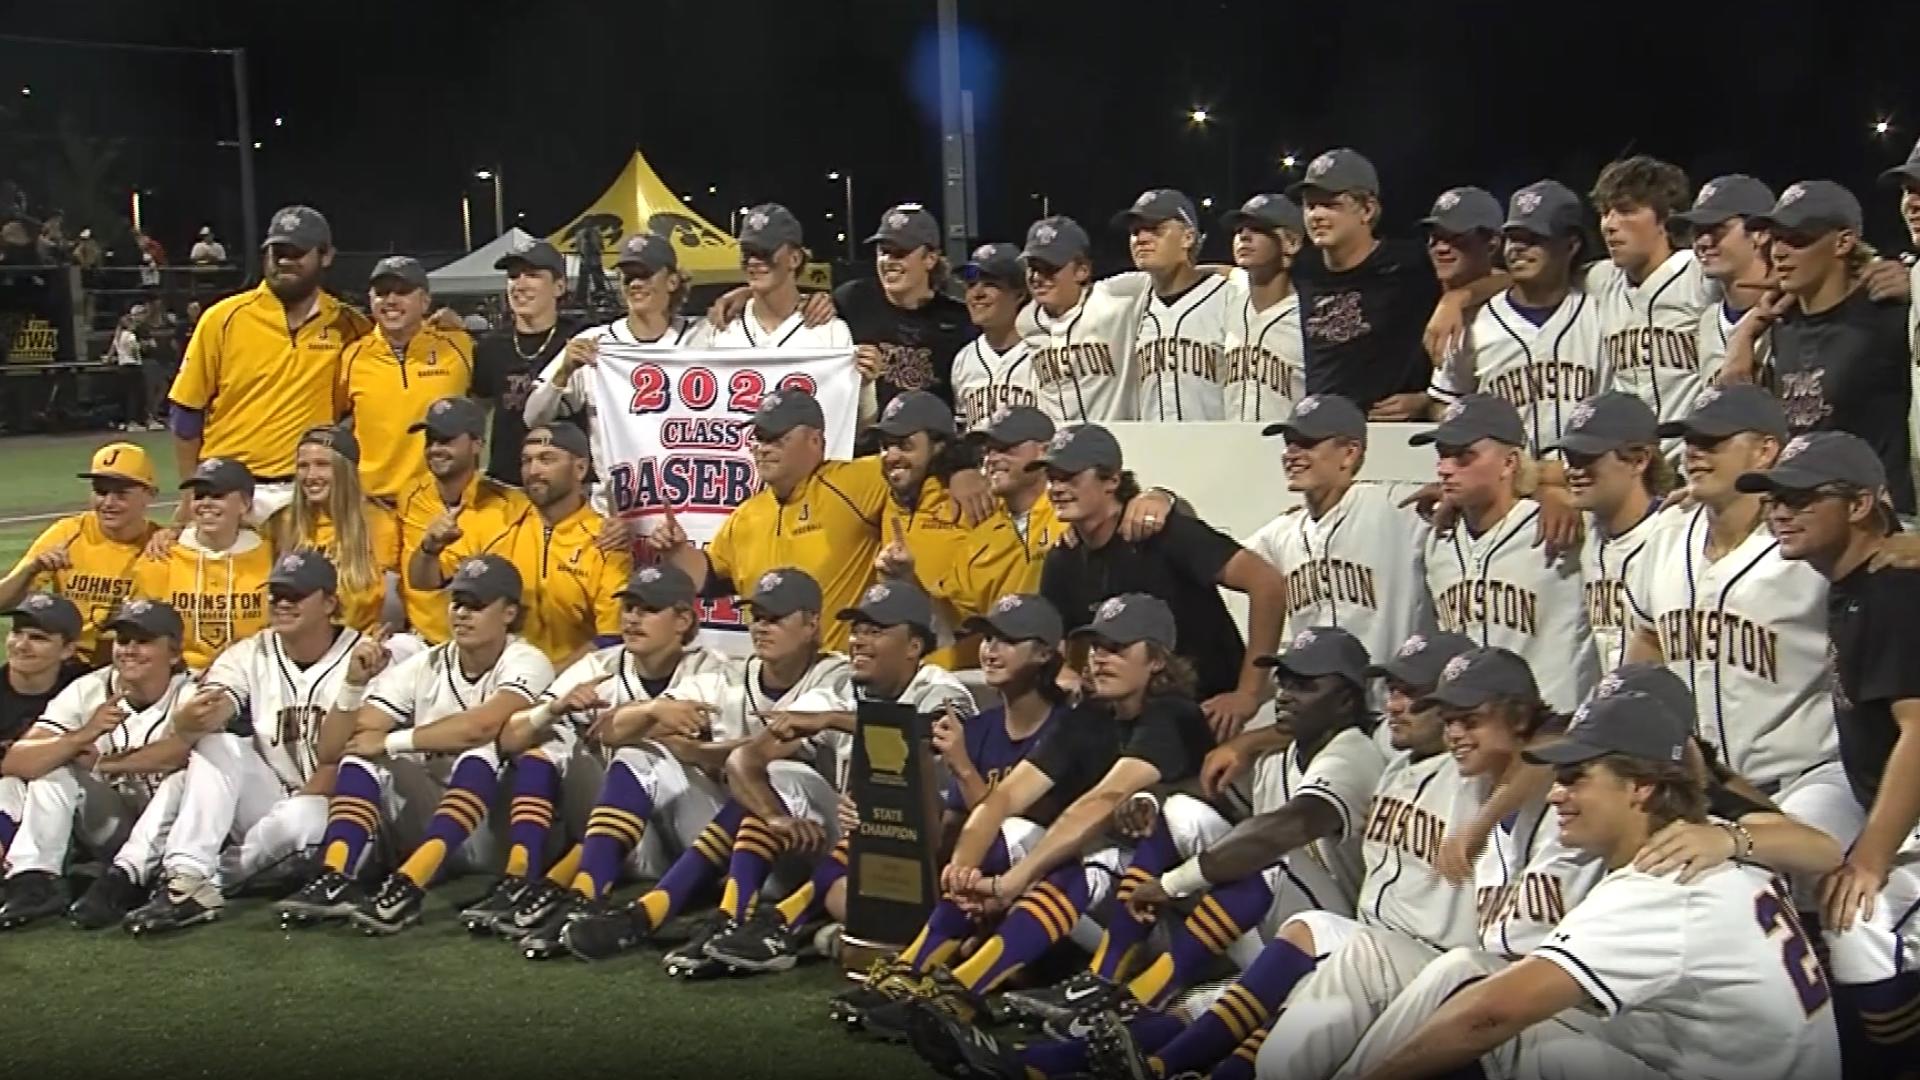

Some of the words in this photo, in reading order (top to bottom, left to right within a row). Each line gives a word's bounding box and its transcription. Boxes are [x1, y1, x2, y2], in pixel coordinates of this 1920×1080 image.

[662, 418, 745, 450] CLASS
[103, 449, 120, 467] J
[873, 808, 904, 822] STATE
[860, 822, 918, 841] CHAMPION
